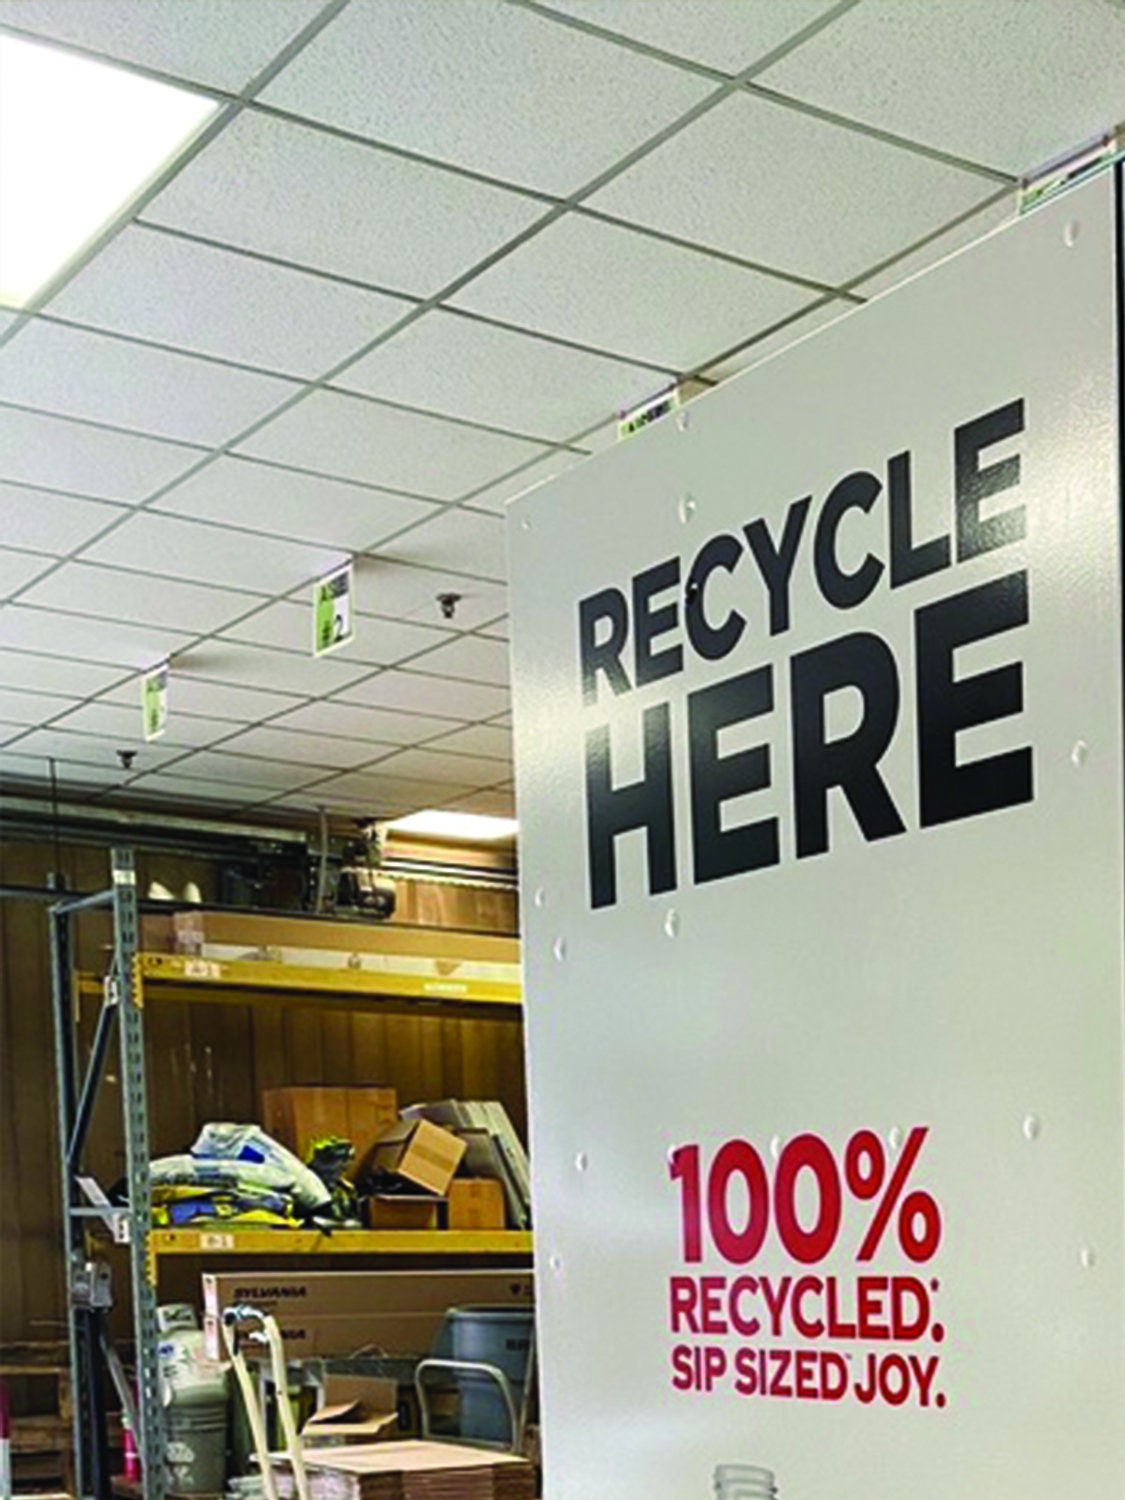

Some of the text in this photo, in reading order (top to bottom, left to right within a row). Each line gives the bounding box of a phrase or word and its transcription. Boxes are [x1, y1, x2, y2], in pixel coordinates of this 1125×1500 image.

[578, 397, 1027, 708] RECYCLE
[584, 568, 1034, 911] HERE
[669, 1126, 942, 1265] 100%
[672, 1344, 946, 1408] SIP SIZED JOY.
